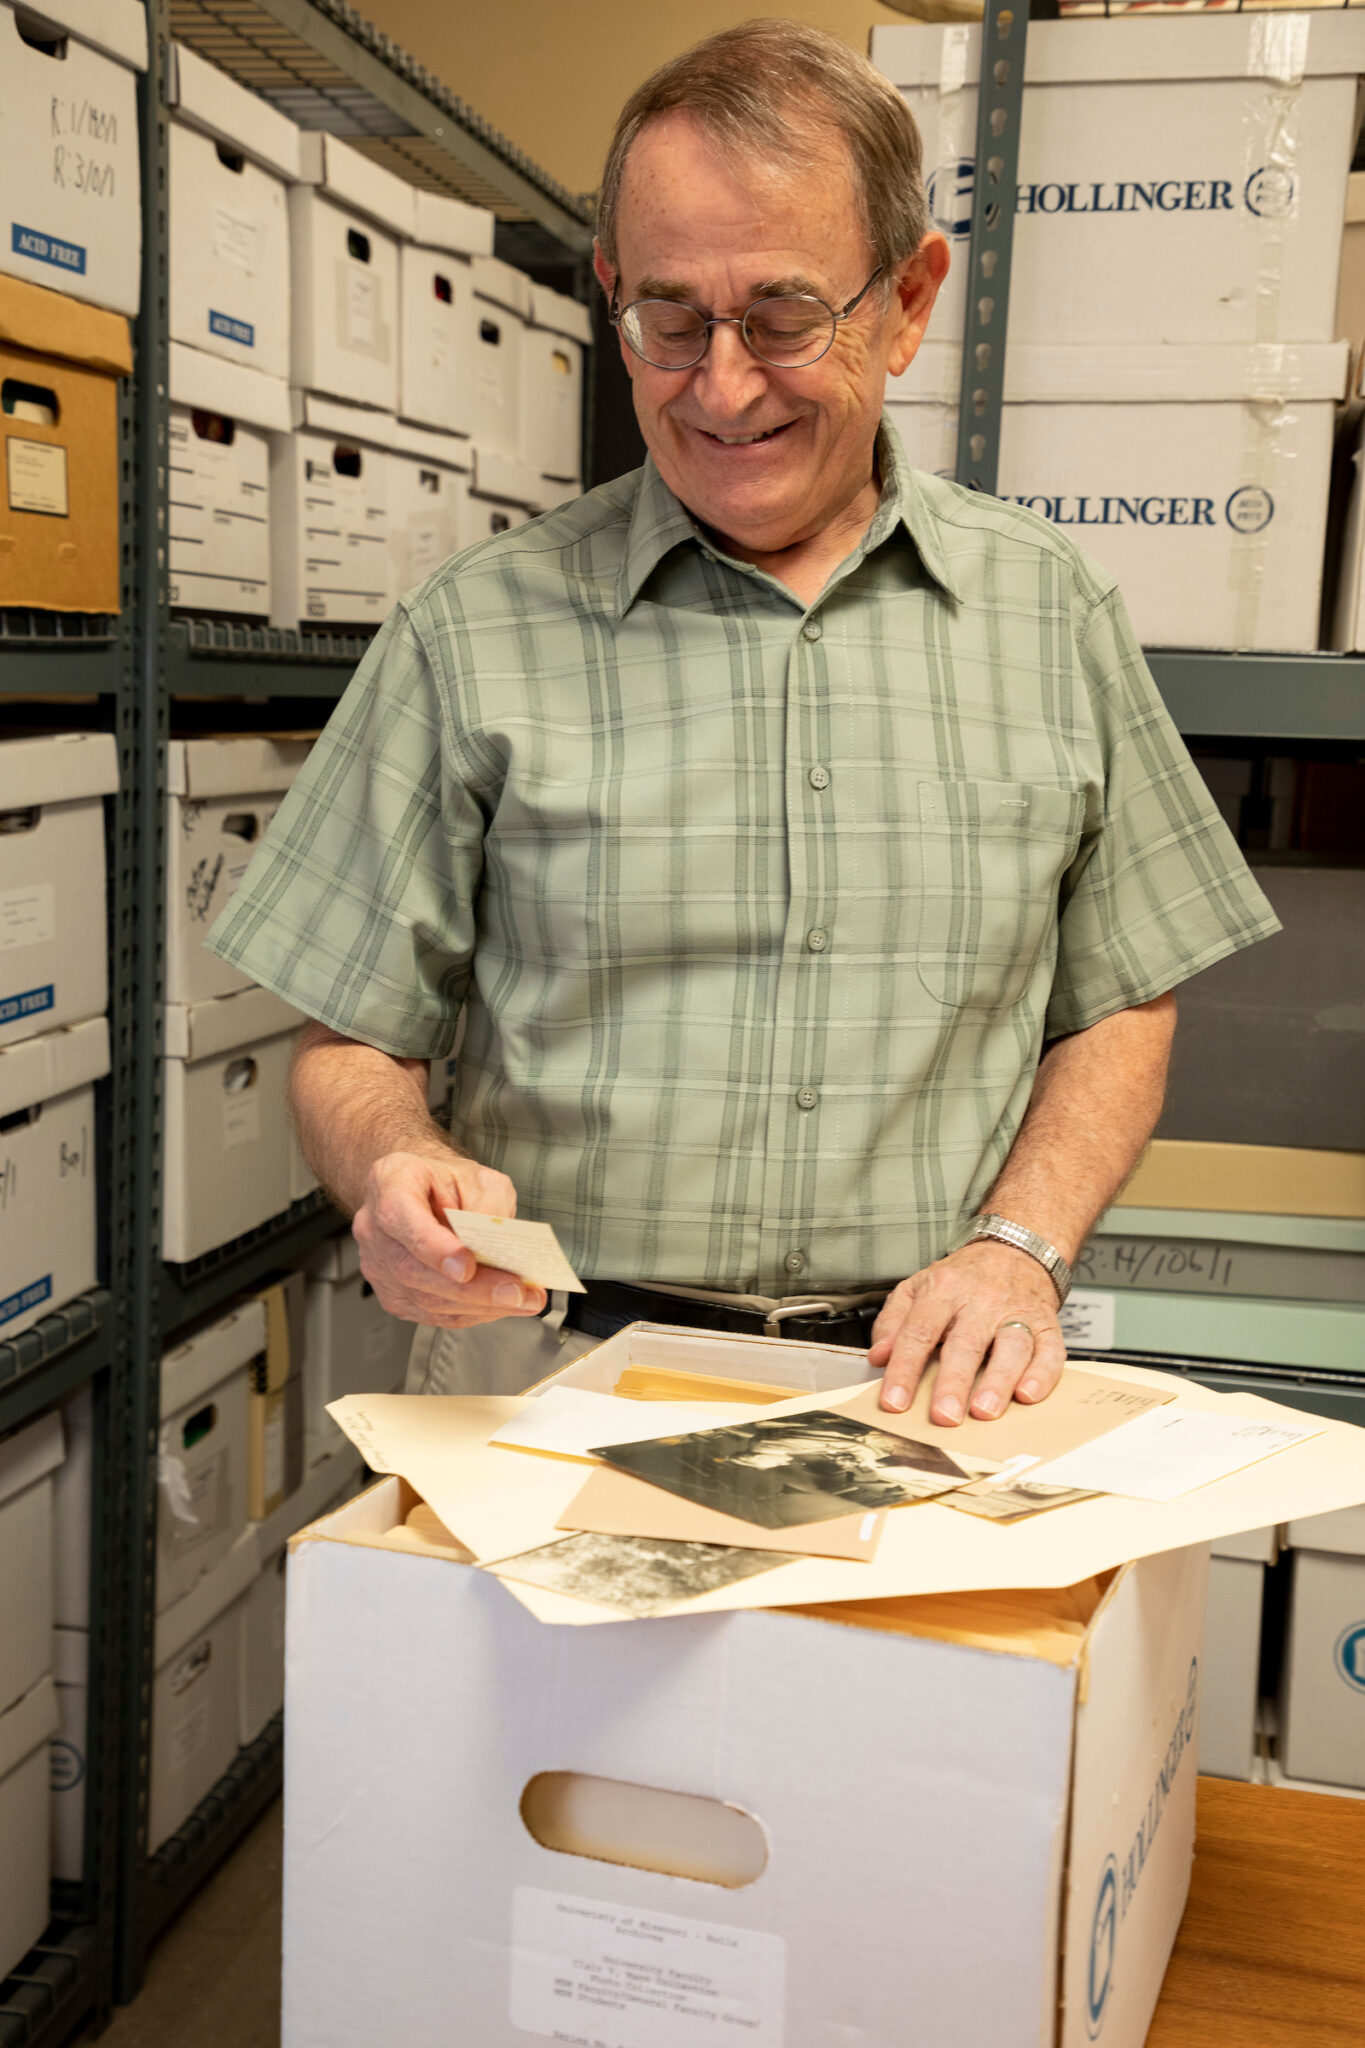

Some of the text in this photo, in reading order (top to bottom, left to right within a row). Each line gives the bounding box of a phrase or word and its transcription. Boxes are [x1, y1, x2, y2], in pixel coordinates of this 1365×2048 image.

[1015, 180, 1235, 214] HOLLINGER
[19, 232, 81, 268] ACID FREE
[999, 496, 1217, 525] OLLINGER
[20, 990, 49, 1013] FREE
[620, 1917, 634, 1927] of
